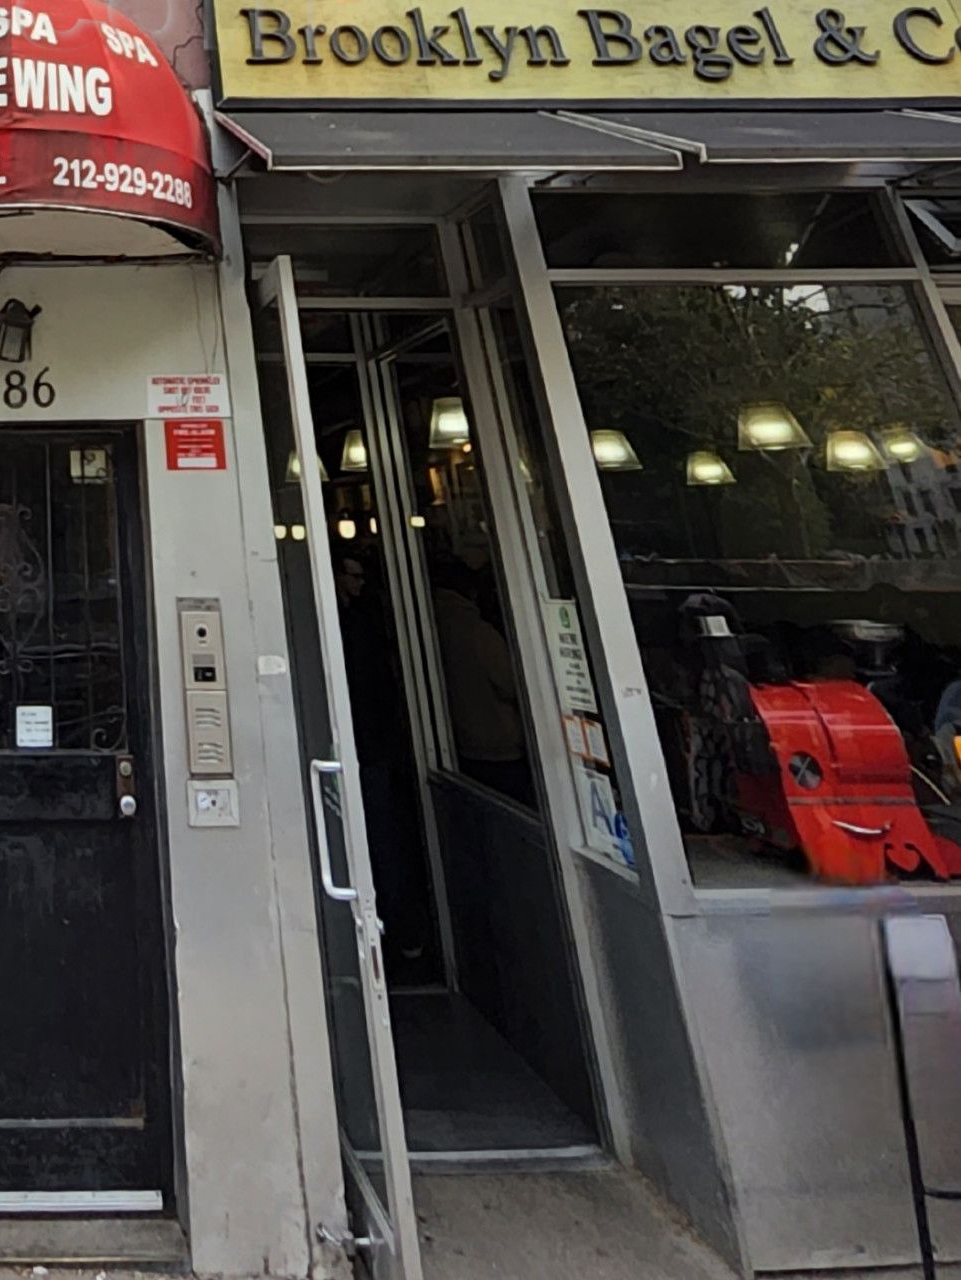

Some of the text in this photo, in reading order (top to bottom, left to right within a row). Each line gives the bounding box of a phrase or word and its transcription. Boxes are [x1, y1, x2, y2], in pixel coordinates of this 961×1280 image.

[100, 22, 158, 67] SPA
[240, 7, 961, 81] Brooklyn Bagel & C
[52, 157, 193, 209] 212-929-2288
